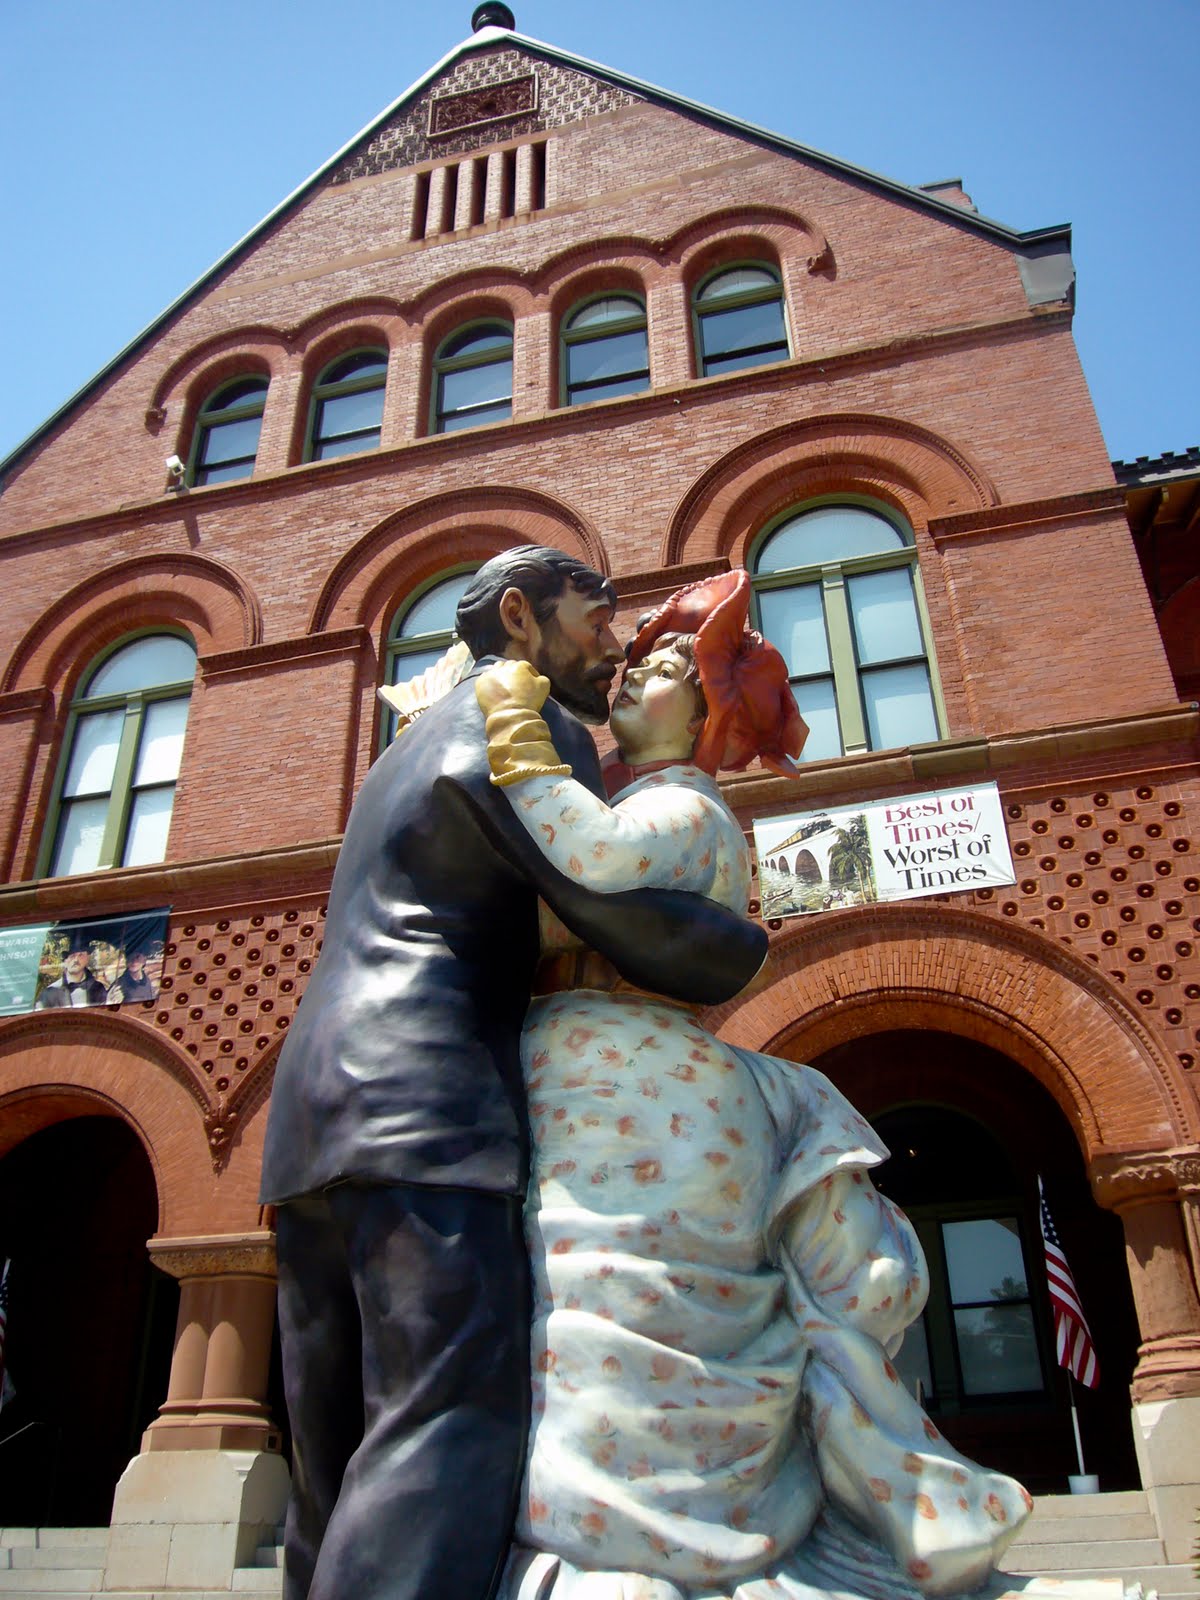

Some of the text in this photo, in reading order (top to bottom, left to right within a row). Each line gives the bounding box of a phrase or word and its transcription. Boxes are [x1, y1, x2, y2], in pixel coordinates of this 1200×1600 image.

[885, 791, 975, 823] Best of
[884, 834, 993, 869] Worst of
[897, 864, 987, 890] Times
